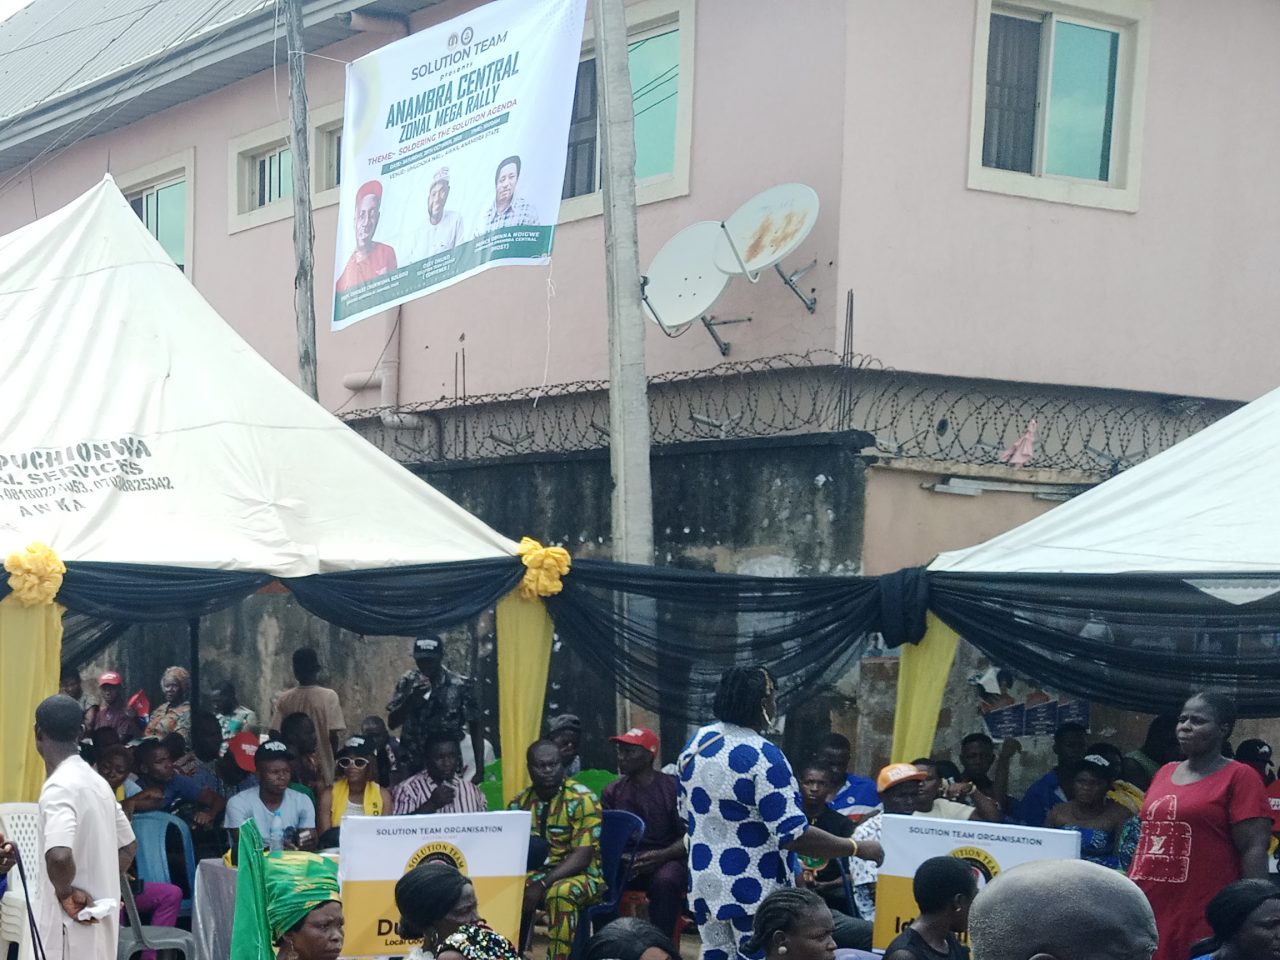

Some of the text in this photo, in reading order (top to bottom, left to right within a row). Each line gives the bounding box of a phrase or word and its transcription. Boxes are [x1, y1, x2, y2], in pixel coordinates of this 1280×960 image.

[411, 30, 508, 81] SOLUTION TEAM
[385, 50, 520, 129] ANAMBRA CENTRAL
[398, 114, 431, 144] ZONAL
[434, 101, 464, 129] MEGA
[464, 83, 501, 116] RALLY
[398, 133, 436, 156] SOLDERING
[437, 127, 451, 141] THE
[451, 112, 486, 133] SOLUTION
[486, 98, 517, 117] AGENDA
[27, 459, 144, 485] SERVICES
[376, 825, 503, 836] SOLUTION TEAM ORGANISATION
[909, 826, 950, 837] SOLUTION
[952, 830, 976, 839] TEAM
[977, 833, 1043, 846] ORGANISATION
[408, 844, 464, 869] SOLUTION TEAM
[982, 854, 999, 877] TEA
